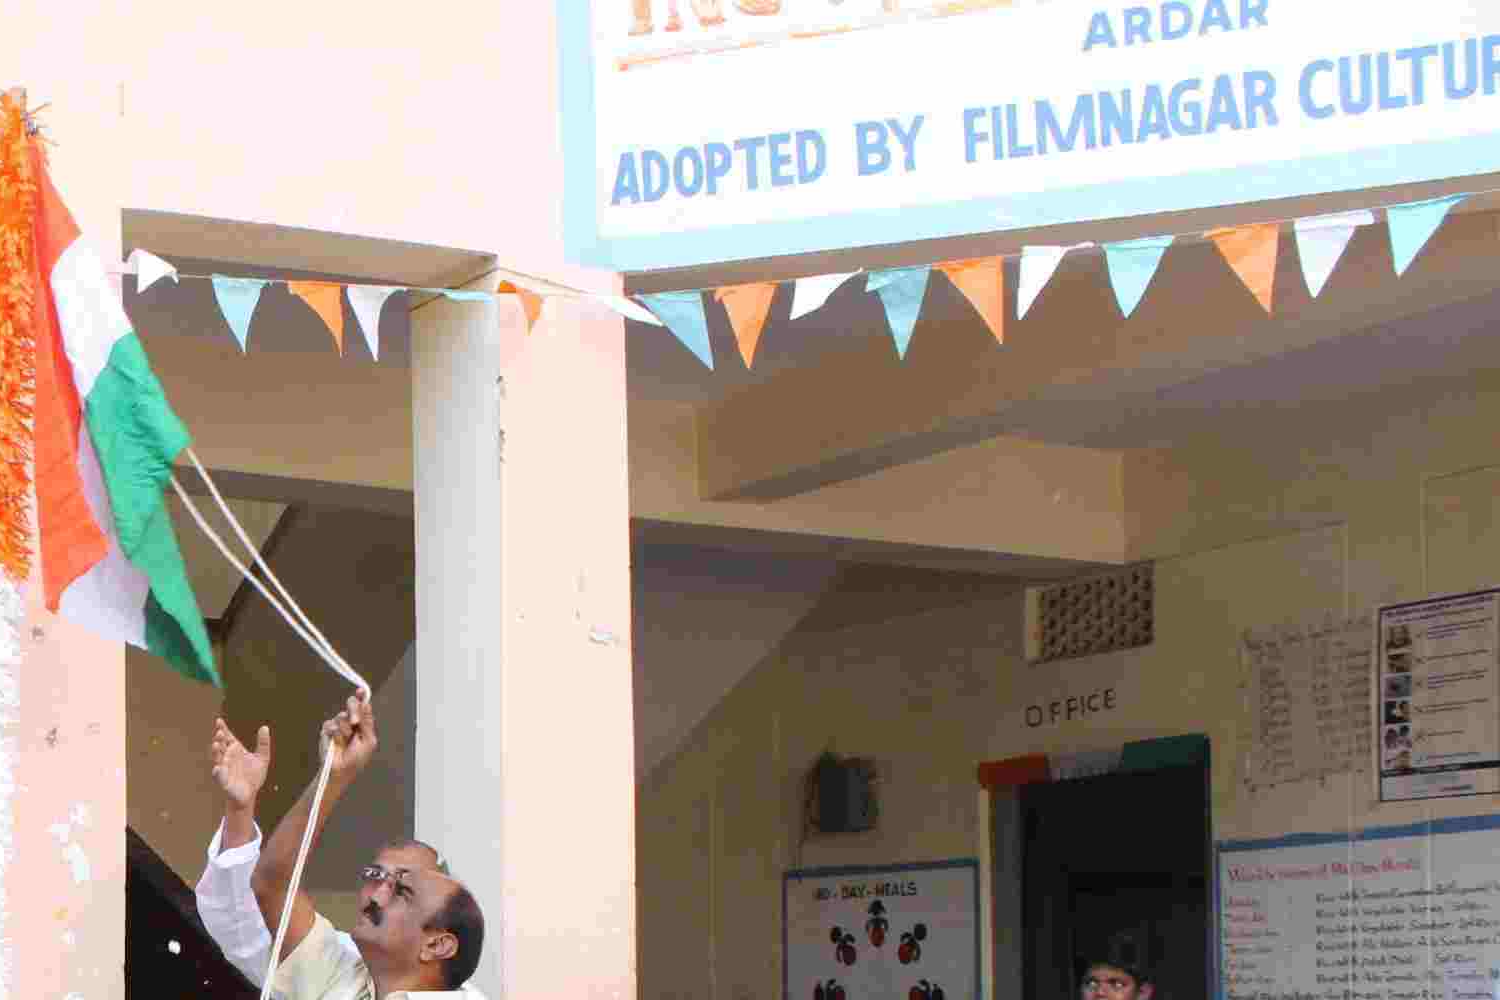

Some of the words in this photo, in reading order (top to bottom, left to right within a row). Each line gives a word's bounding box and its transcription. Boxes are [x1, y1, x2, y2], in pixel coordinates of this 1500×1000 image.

[610, 129, 826, 206] ADOPTED
[853, 114, 924, 175] BY
[962, 70, 1279, 162] FILMNAGAR
[1025, 687, 1117, 728] OFFICE
